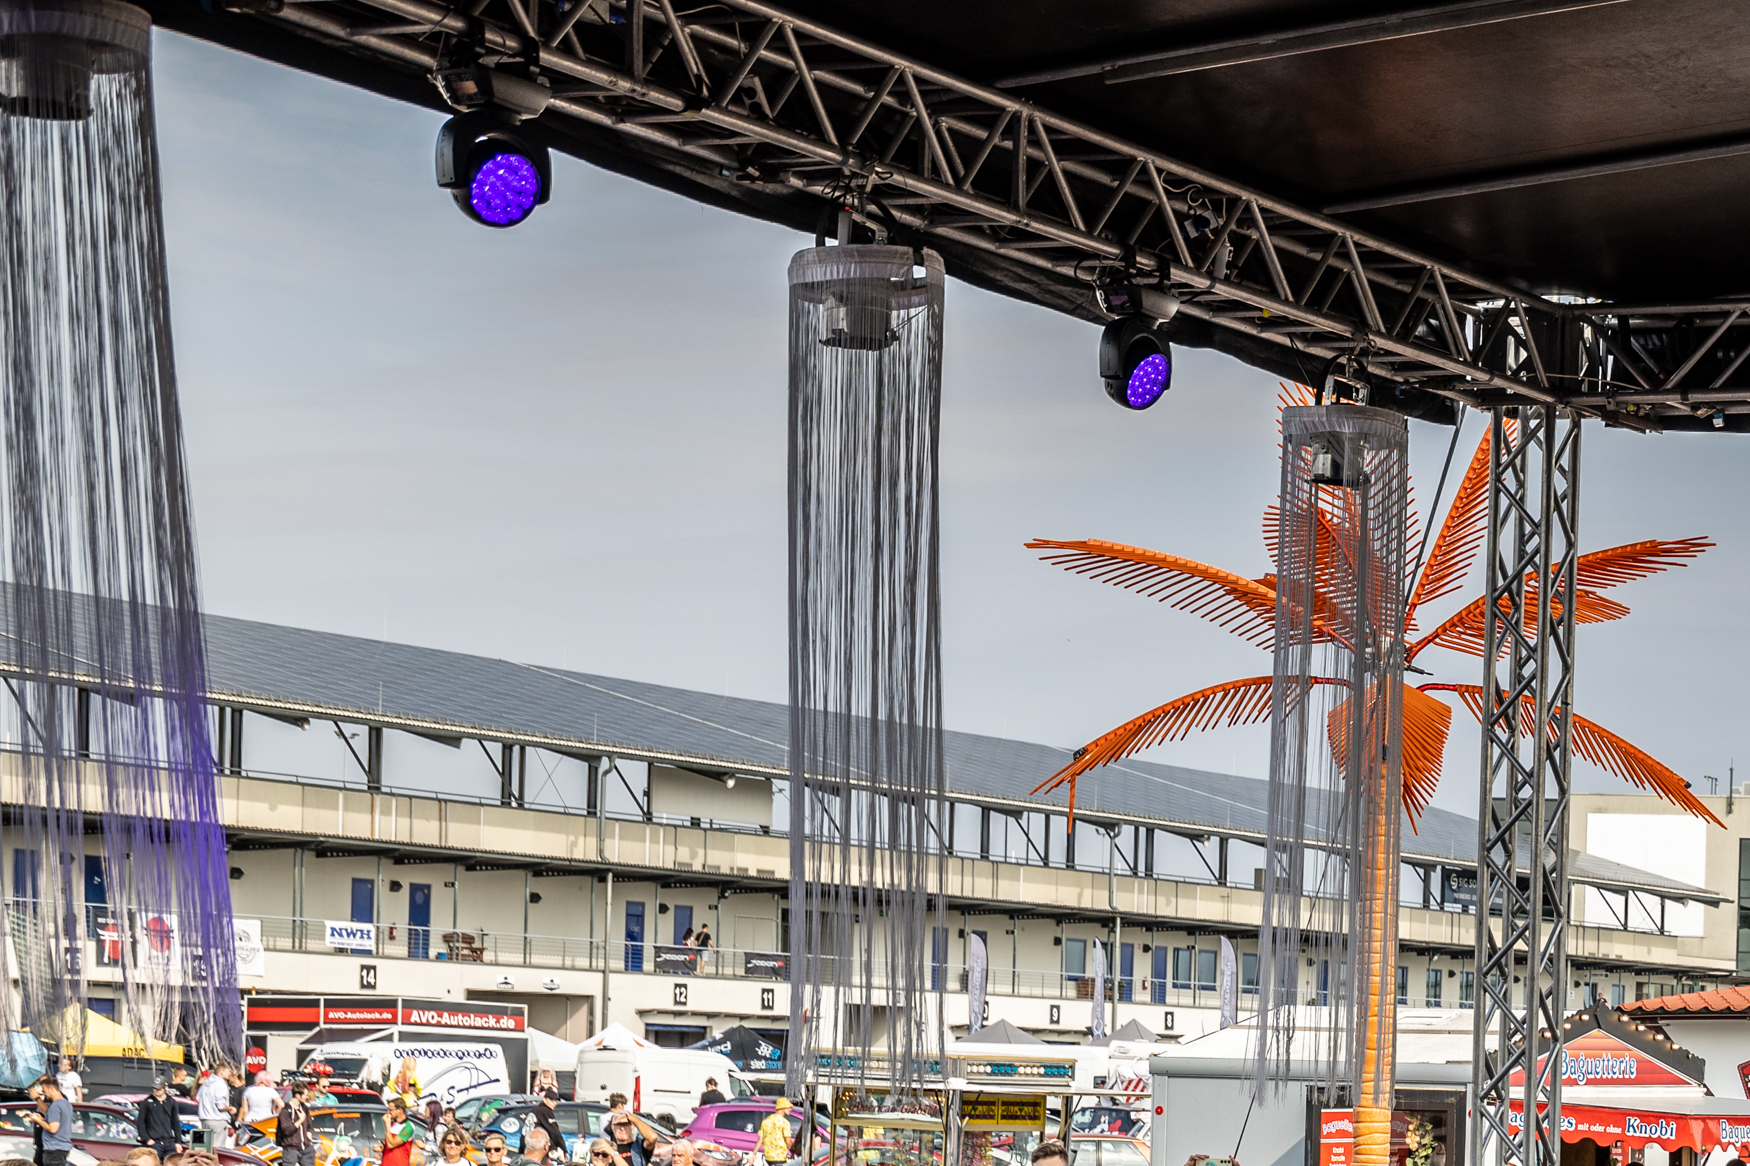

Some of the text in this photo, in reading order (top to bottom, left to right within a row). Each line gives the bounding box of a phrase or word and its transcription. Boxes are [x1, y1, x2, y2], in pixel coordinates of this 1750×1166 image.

[330, 926, 372, 940] NWH
[361, 969, 376, 986] 14
[675, 987, 687, 1002] 12
[762, 991, 773, 1007] 11
[328, 1011, 392, 1020] AVO-Autolack.de
[410, 1011, 515, 1029] AVO-Autolack.de
[1052, 1009, 1058, 1021] 9
[1166, 1015, 1173, 1027] 8
[122, 1048, 145, 1057] ADAC
[246, 1056, 266, 1065] AVO
[1561, 1050, 1636, 1085] Baguetterie
[1577, 1116, 1676, 1139] mit oder ohne Knobi
